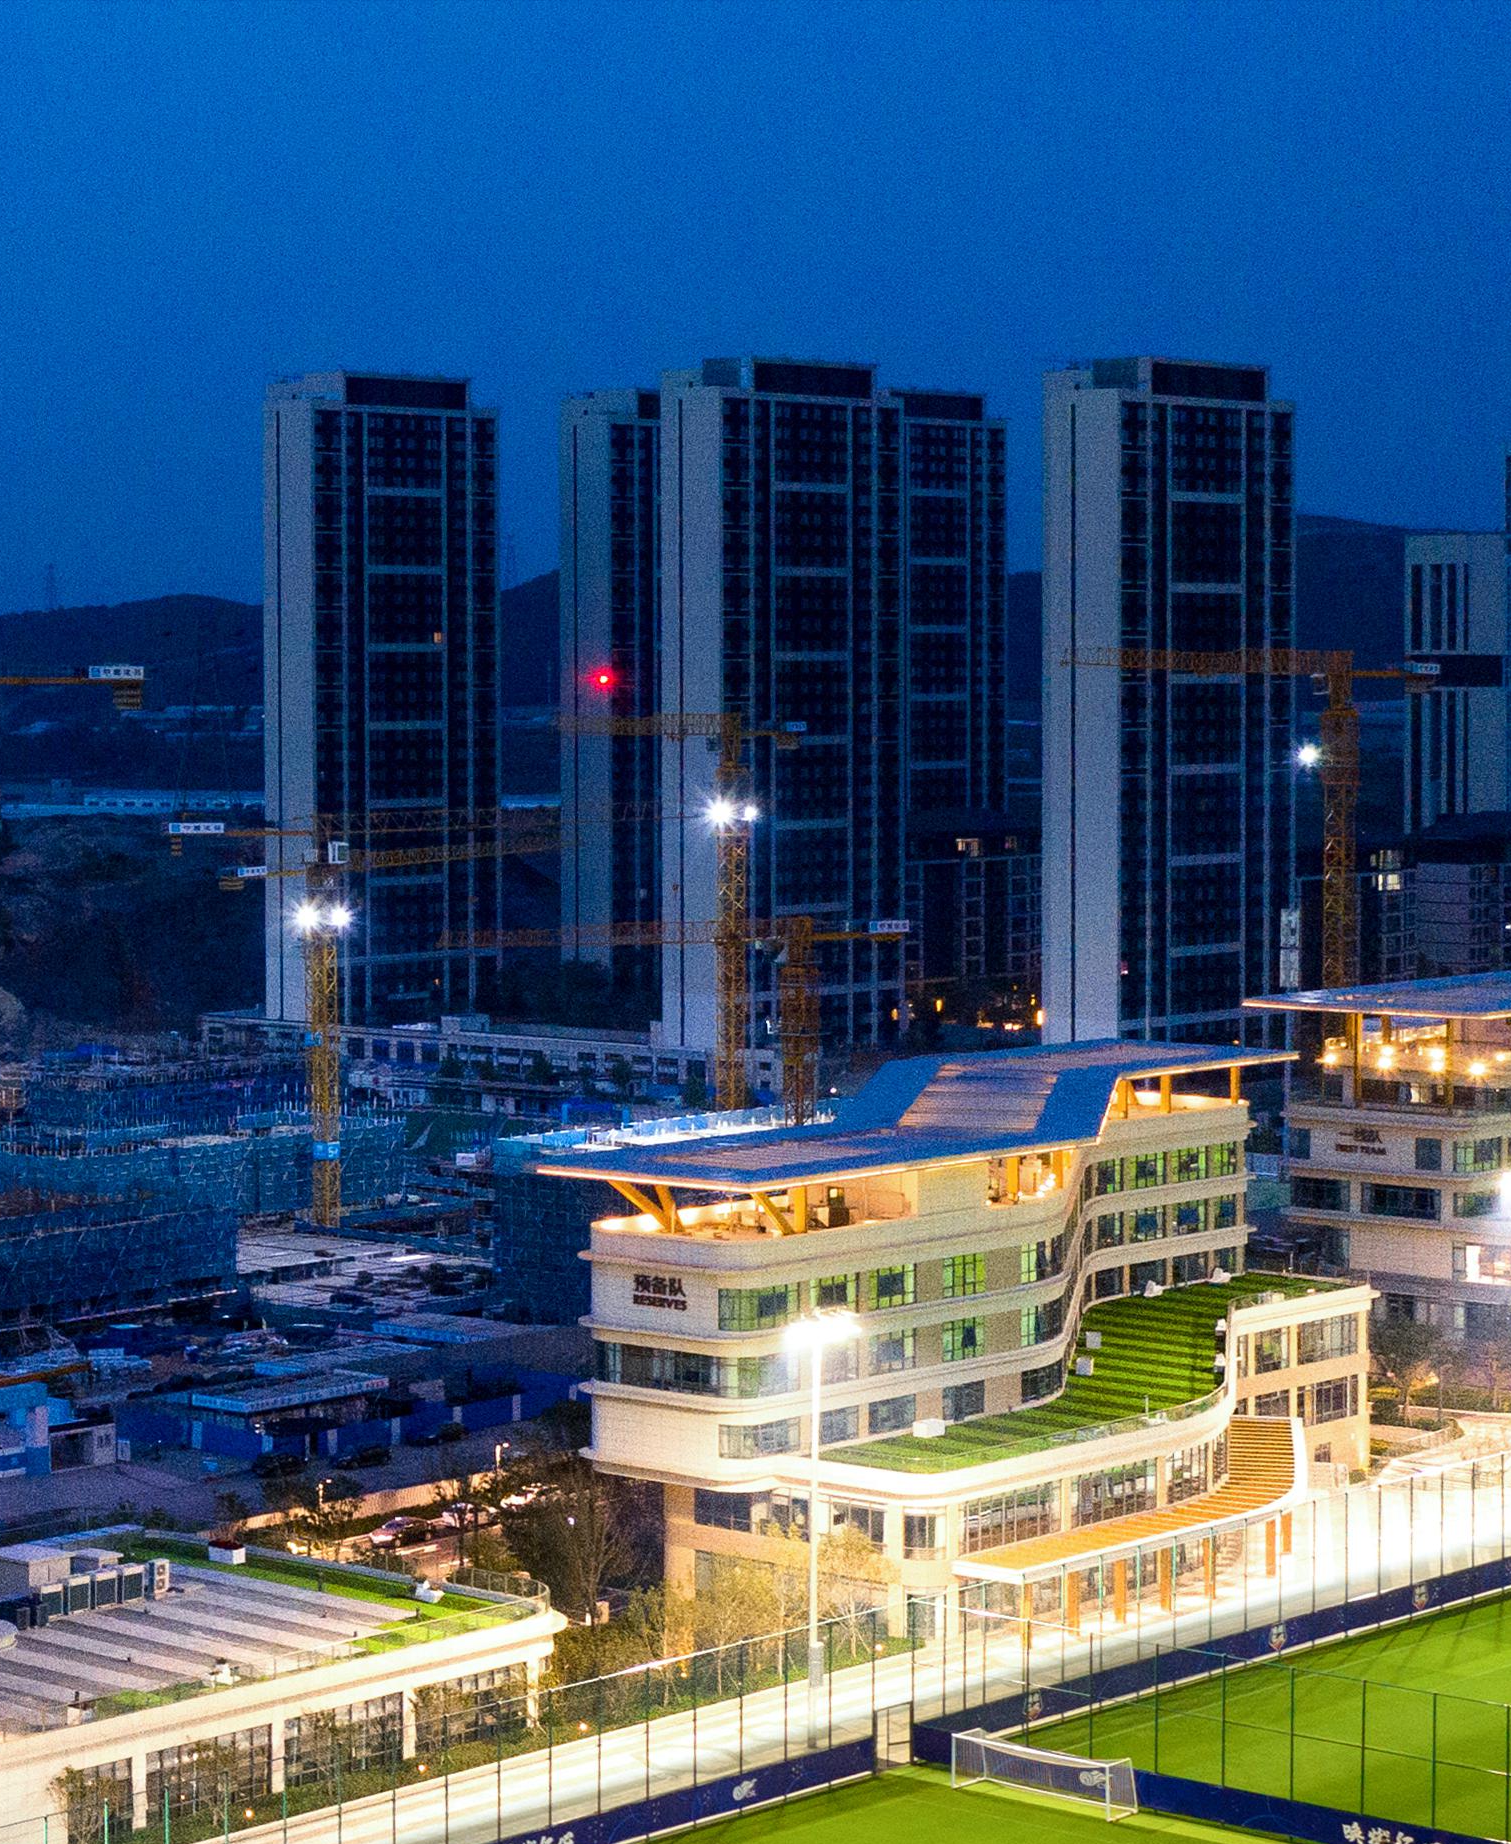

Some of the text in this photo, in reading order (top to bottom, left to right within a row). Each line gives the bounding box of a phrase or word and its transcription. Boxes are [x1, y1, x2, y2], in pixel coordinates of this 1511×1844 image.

[633, 1274, 686, 1297] 预备队
[632, 1294, 688, 1311] RESERVES
